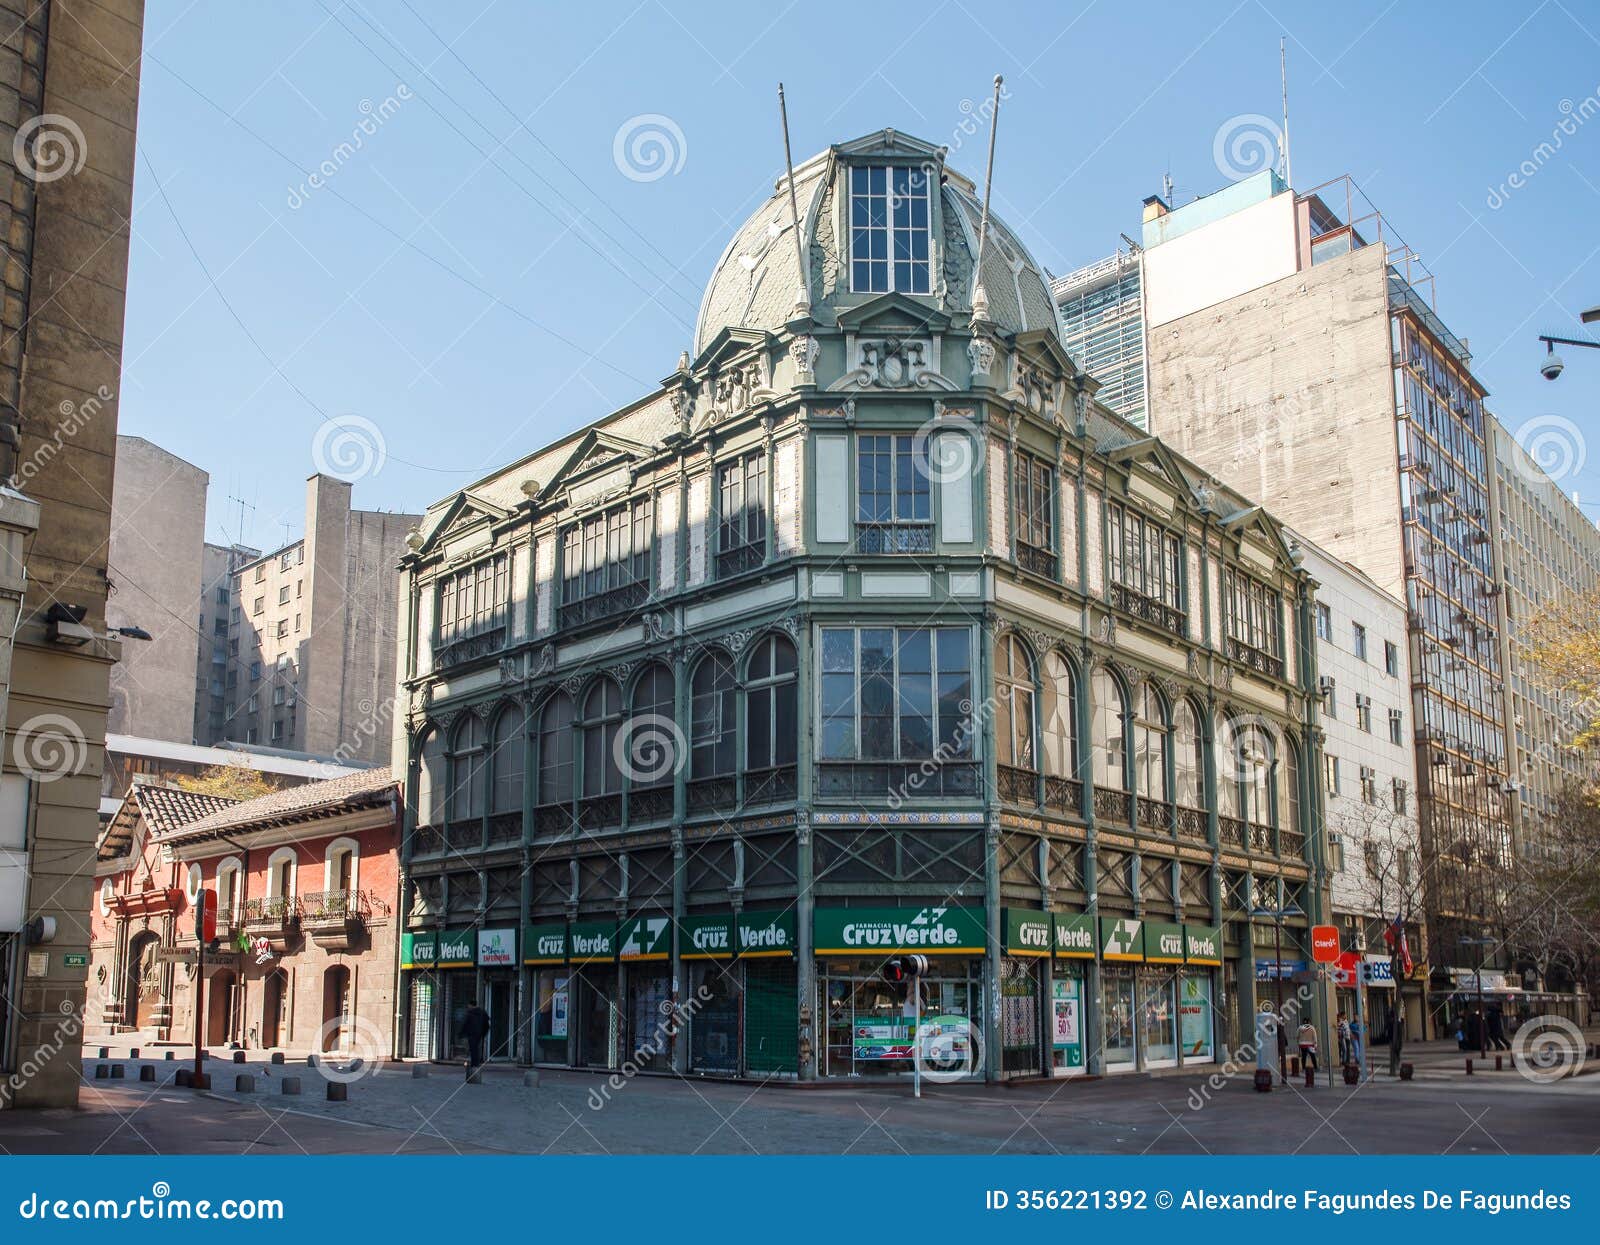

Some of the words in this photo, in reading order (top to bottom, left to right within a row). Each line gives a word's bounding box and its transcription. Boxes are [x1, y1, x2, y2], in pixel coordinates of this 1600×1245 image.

[538, 936, 564, 955] Cruz
[572, 933, 610, 954] Verde
[693, 928, 729, 949] Cruz
[739, 923, 787, 948] Verde
[1020, 922, 1048, 946] Cruz
[1056, 925, 1092, 948] Verde
[1160, 934, 1182, 954] Cruz
[1187, 936, 1215, 956] Verde
[413, 943, 434, 960] Cruz
[440, 941, 470, 959] Verde
